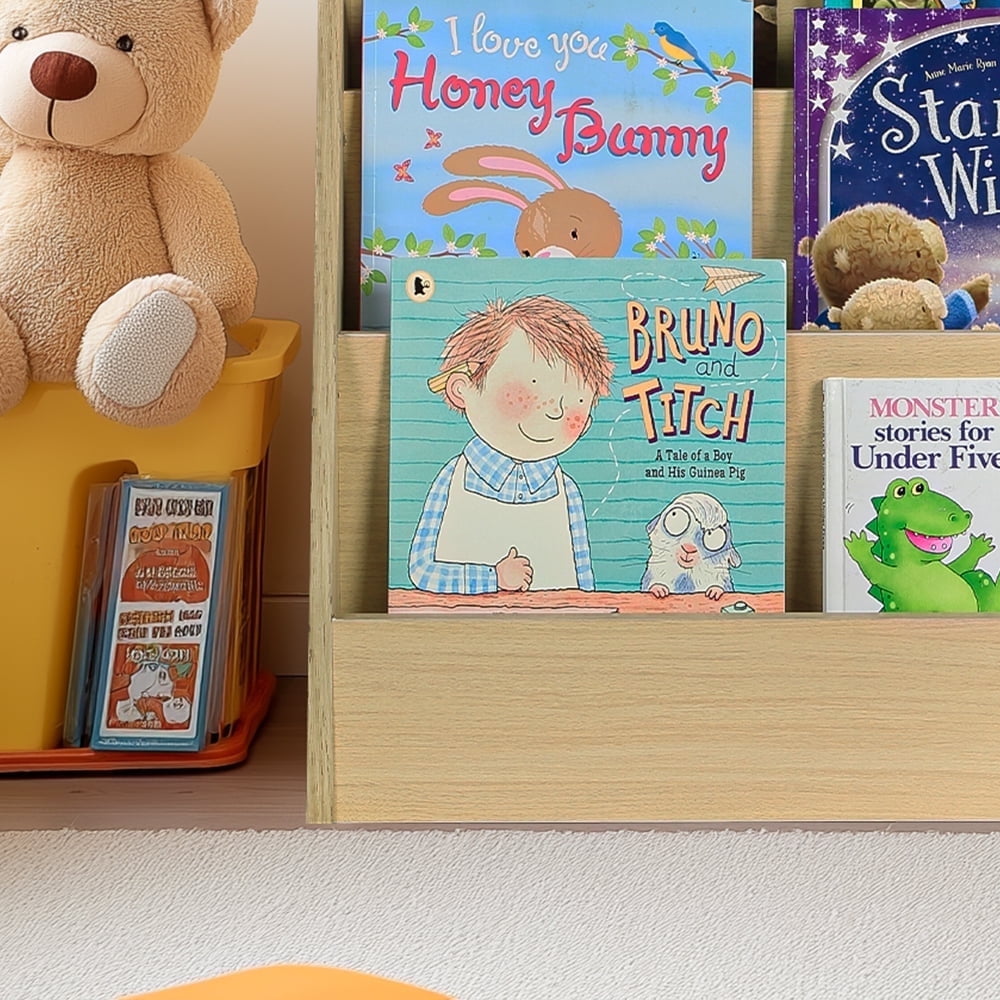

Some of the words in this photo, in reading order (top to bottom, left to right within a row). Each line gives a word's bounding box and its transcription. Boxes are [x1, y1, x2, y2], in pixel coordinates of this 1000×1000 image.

[444, 15, 463, 56] I
[471, 11, 541, 60] love
[547, 29, 608, 72] you
[924, 69, 946, 82] Anne
[947, 62, 974, 75] Marie
[975, 58, 997, 72] Ryan
[389, 50, 556, 135] Honey
[555, 98, 729, 182] Bunny
[626, 301, 765, 376] BRUNO
[695, 352, 740, 378] and
[869, 397, 1000, 418] MONSTER
[874, 421, 951, 442] stories
[959, 420, 995, 442] for
[655, 449, 663, 461] A
[665, 449, 688, 461] Tale
[690, 449, 702, 461] of
[704, 452, 710, 461] a
[713, 449, 733, 464] Boy
[850, 444, 942, 469] Under
[645, 466, 664, 478] and
[668, 466, 686, 478] His
[689, 466, 725, 478] Guinea
[728, 466, 746, 481] Pig
